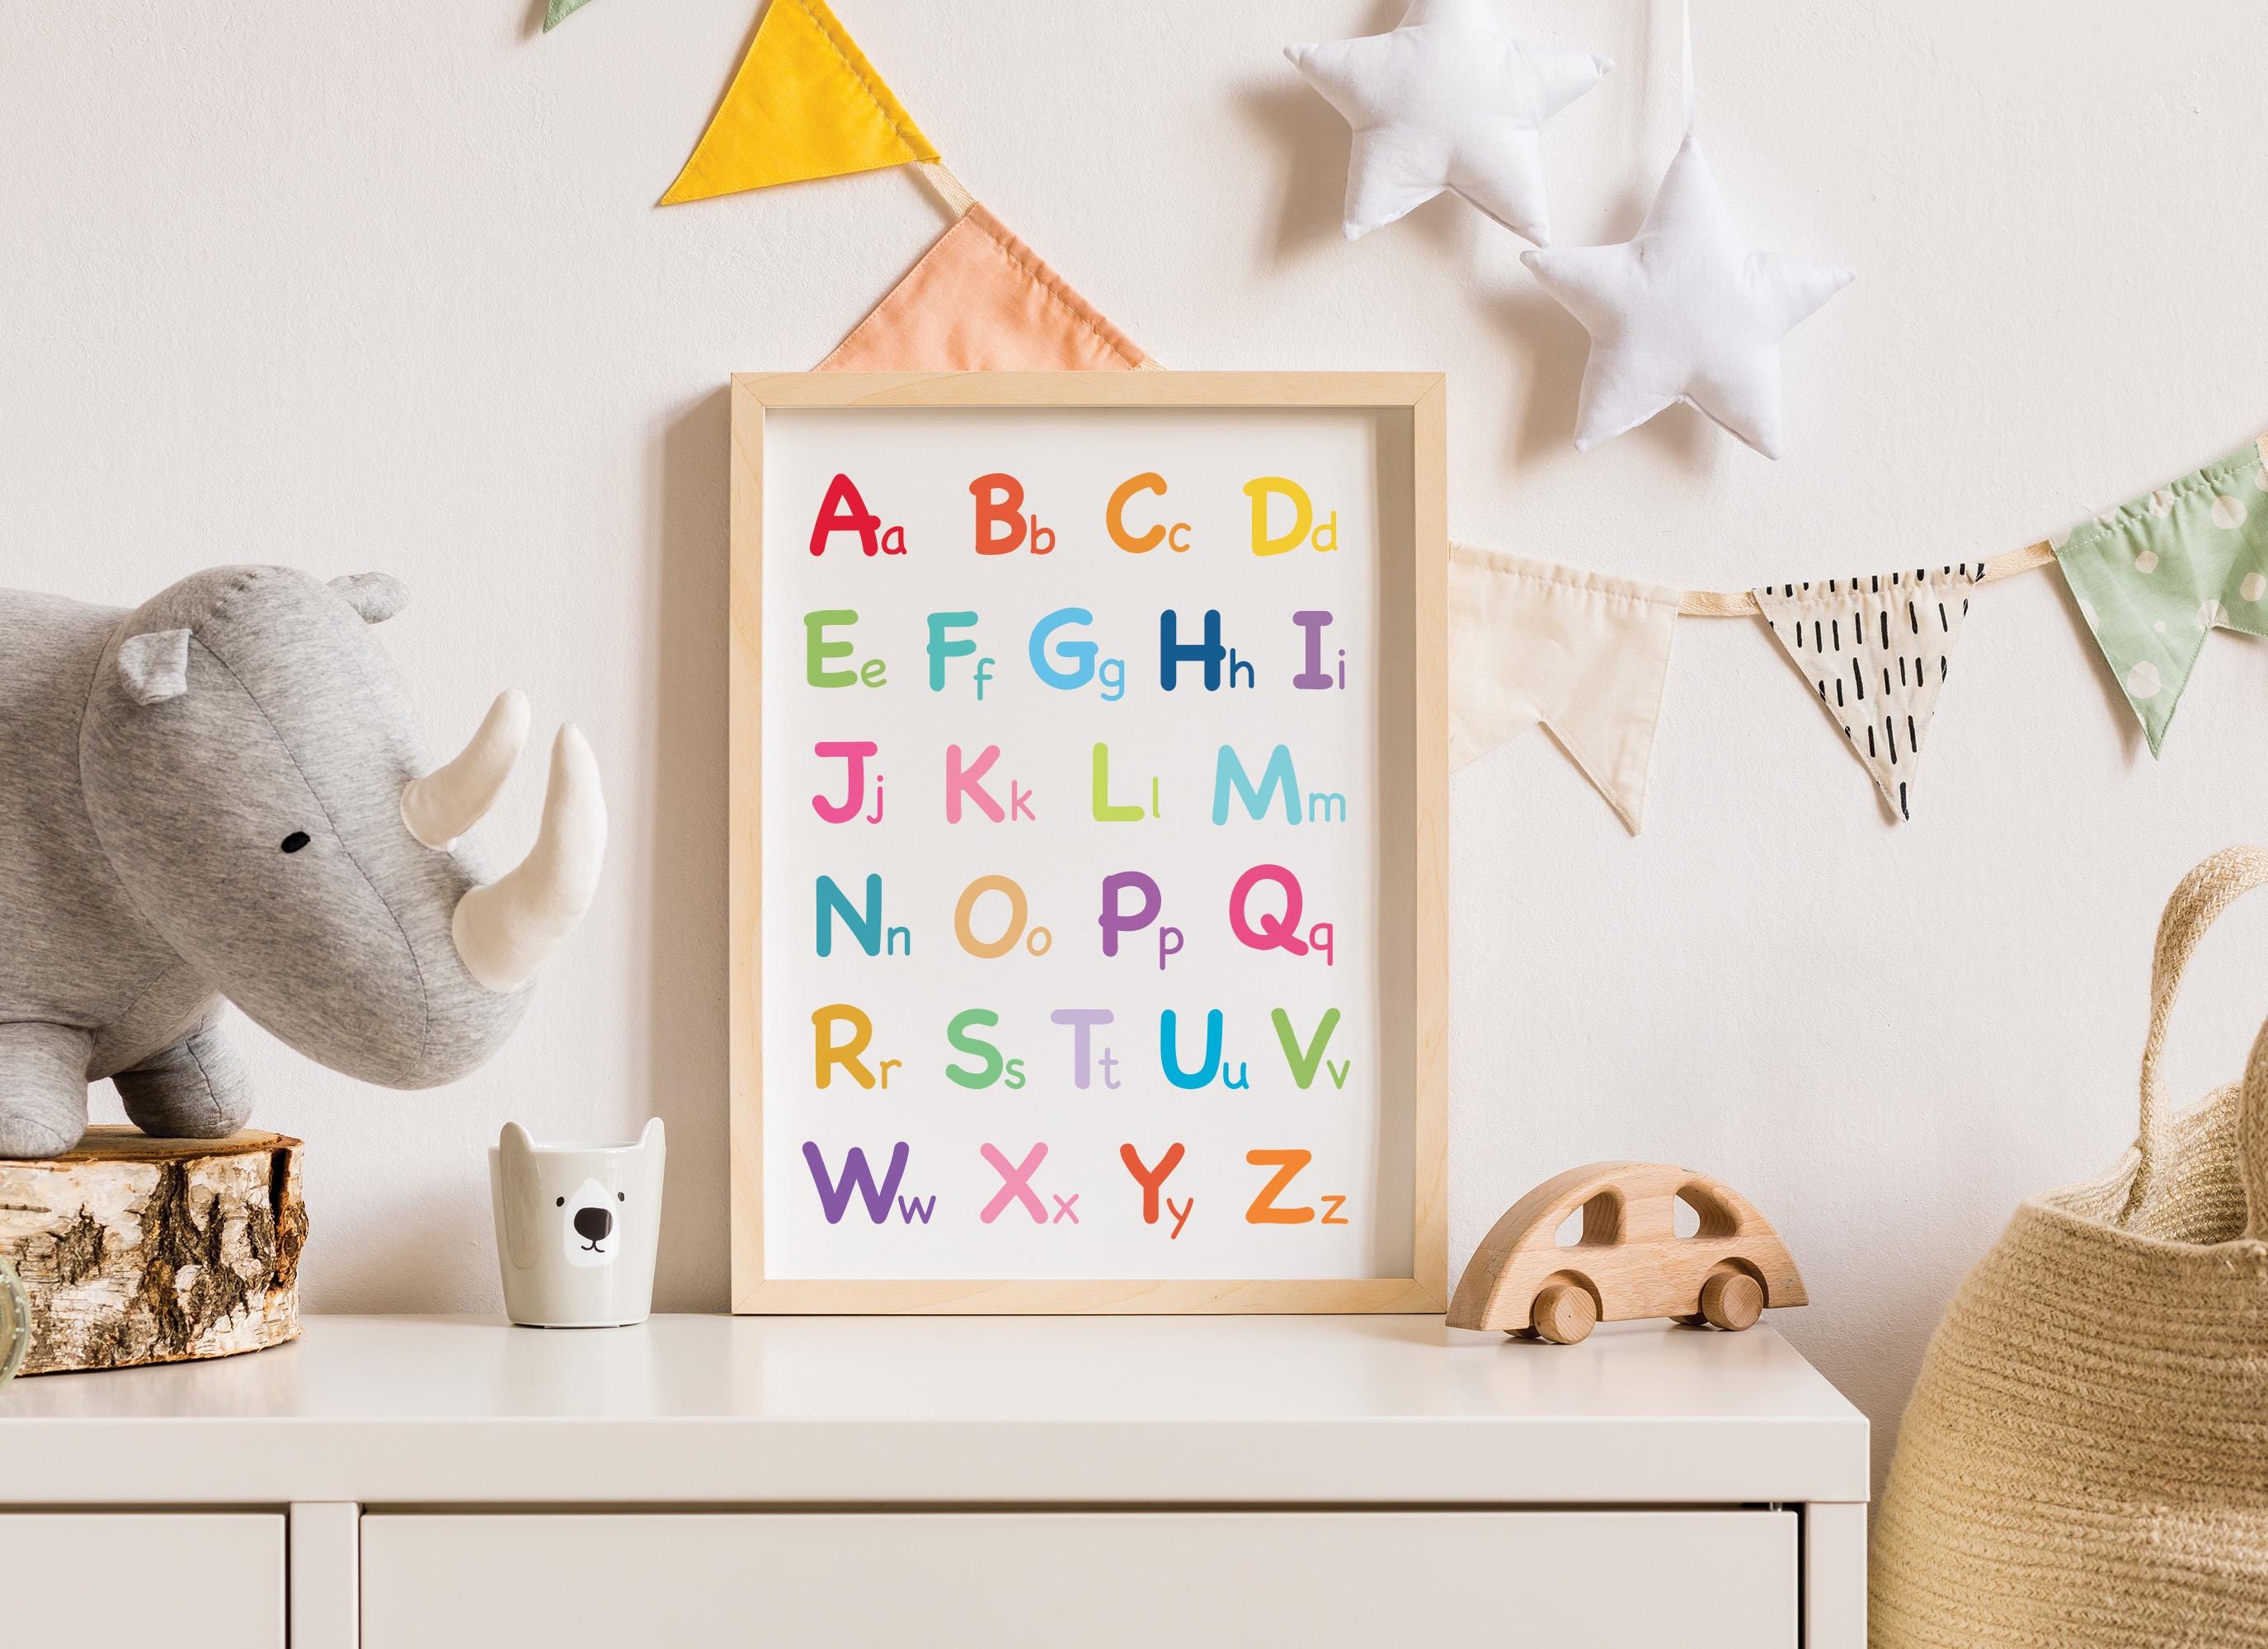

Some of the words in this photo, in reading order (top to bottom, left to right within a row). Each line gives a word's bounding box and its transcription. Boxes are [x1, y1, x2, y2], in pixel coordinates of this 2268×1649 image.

[809, 472, 907, 557] Aa
[968, 472, 1056, 557] Bb
[1105, 472, 1193, 554] Cc
[1242, 476, 1339, 557] Dd
[803, 608, 888, 689] Ee
[926, 610, 996, 701] Ff
[1028, 607, 1126, 702] Gg
[1160, 608, 1255, 692] Hh
[1292, 610, 1346, 691] Ii
[812, 740, 884, 825] Jj
[945, 744, 1037, 824] Kk
[1091, 741, 1161, 823] Ll
[1212, 744, 1347, 826] Mm
[815, 873, 911, 958] Nn
[953, 874, 1053, 960] Oo
[1098, 871, 1185, 971] Pp
[1228, 863, 1334, 967] Qq
[811, 1003, 903, 1091] Rr
[944, 1008, 1027, 1091] Ss
[1050, 1008, 1122, 1091] Tt
[1159, 1008, 1250, 1091] Uu
[1270, 1007, 1351, 1091] Vv
[802, 1141, 937, 1225] Ww
[979, 1141, 1080, 1225] Xx
[1119, 1142, 1195, 1240] Yy
[1245, 1148, 1350, 1225] Zz
